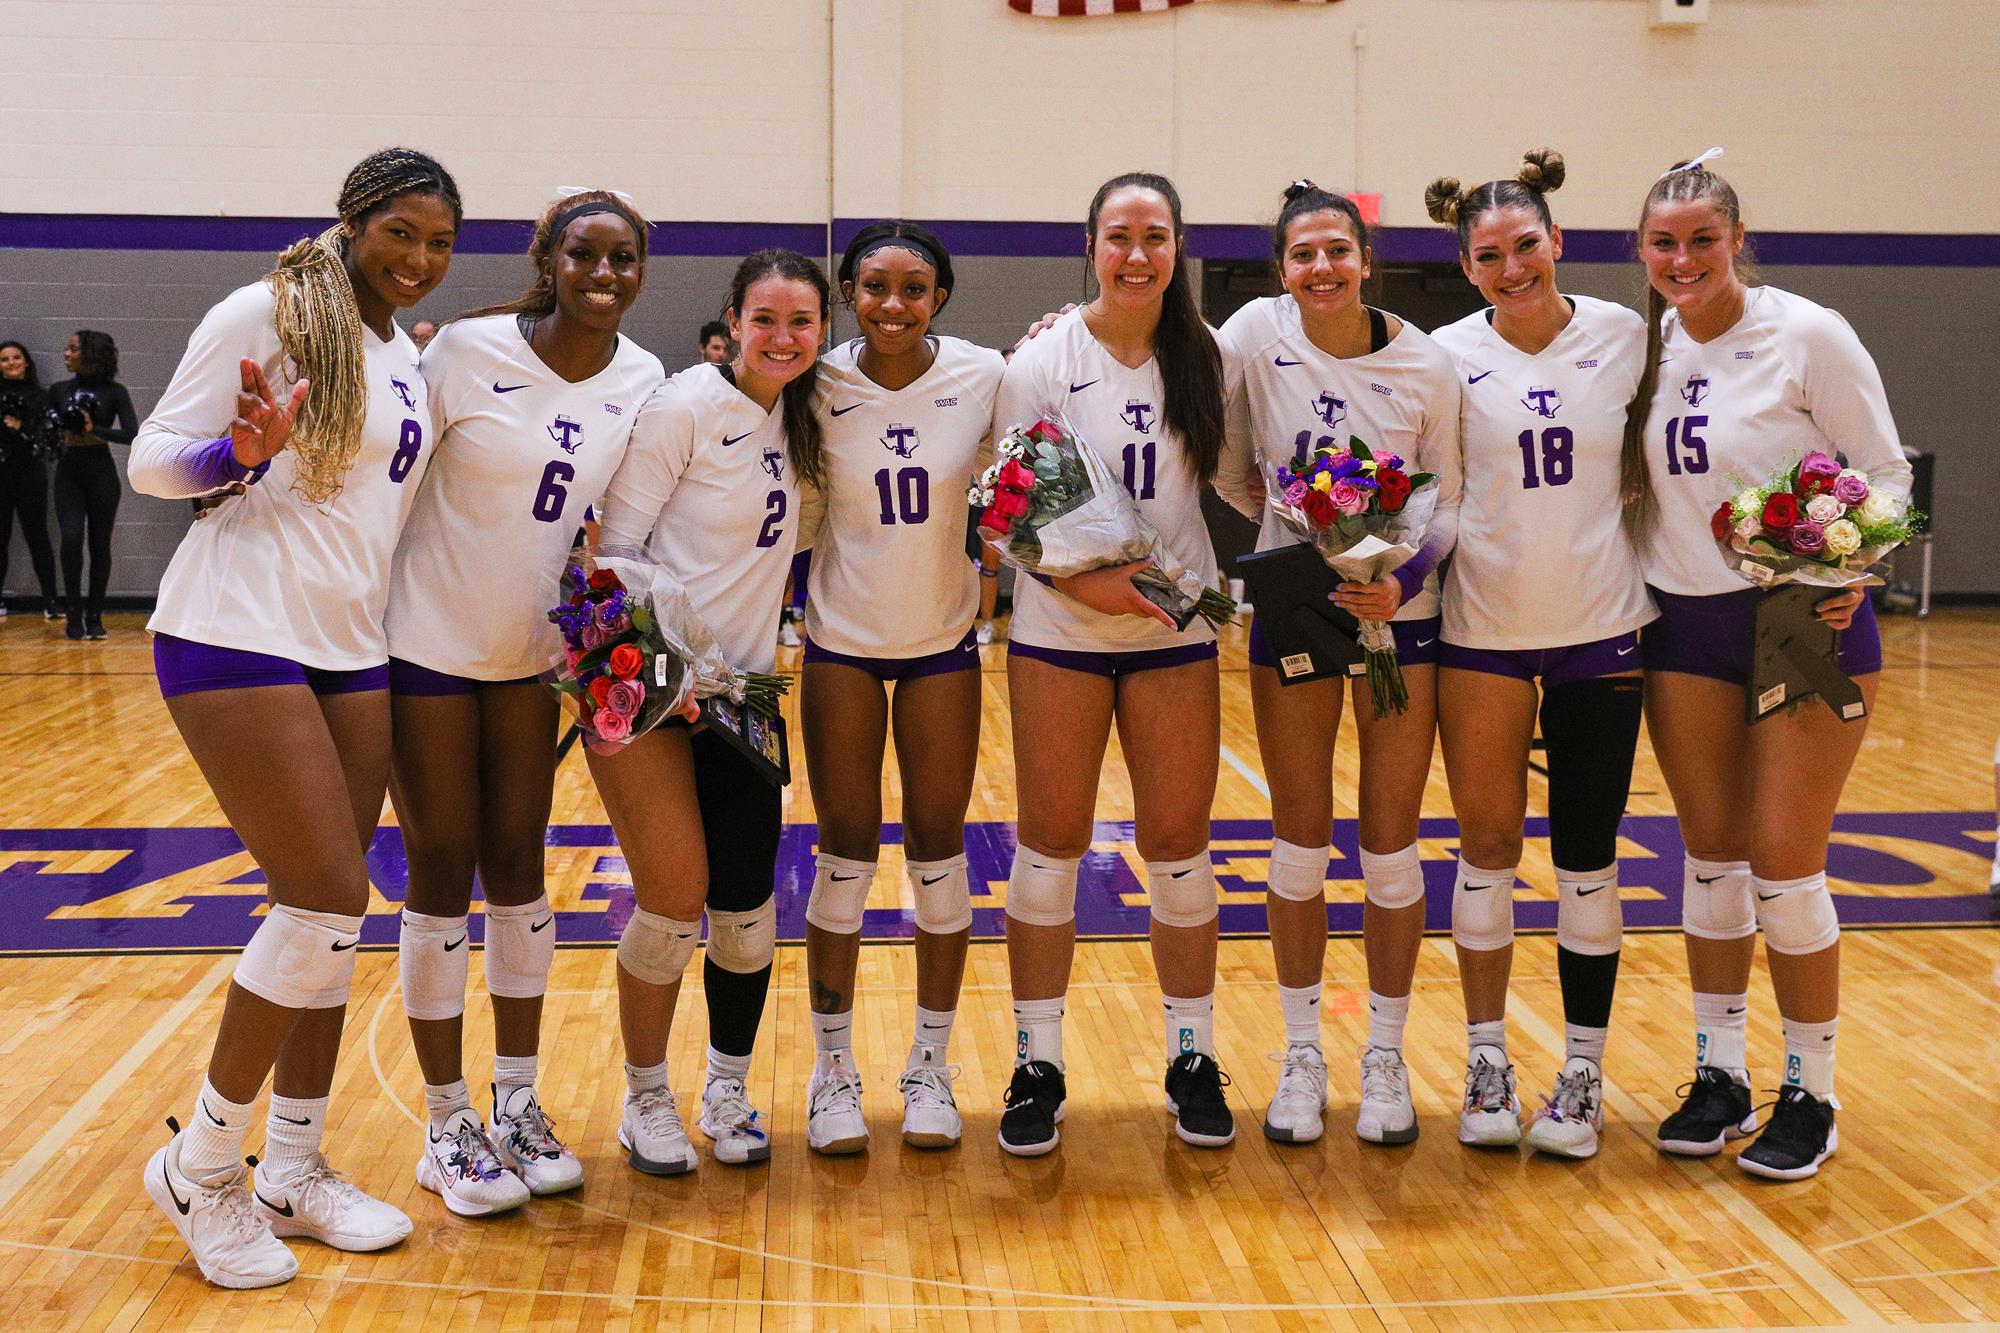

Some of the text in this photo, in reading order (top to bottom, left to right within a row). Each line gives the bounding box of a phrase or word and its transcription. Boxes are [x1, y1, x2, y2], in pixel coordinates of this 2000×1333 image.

[1371, 383, 1393, 396] WAC
[1576, 360, 1598, 369] WAC
[604, 403, 623, 416] WAC
[935, 397, 958, 408] WAC
[389, 418, 422, 483] 8
[1122, 442, 1156, 500] 11
[1518, 426, 1574, 489] 18
[1665, 415, 1709, 475] 15
[532, 460, 575, 523] 6
[756, 489, 787, 548] 2
[874, 466, 930, 525] 10
